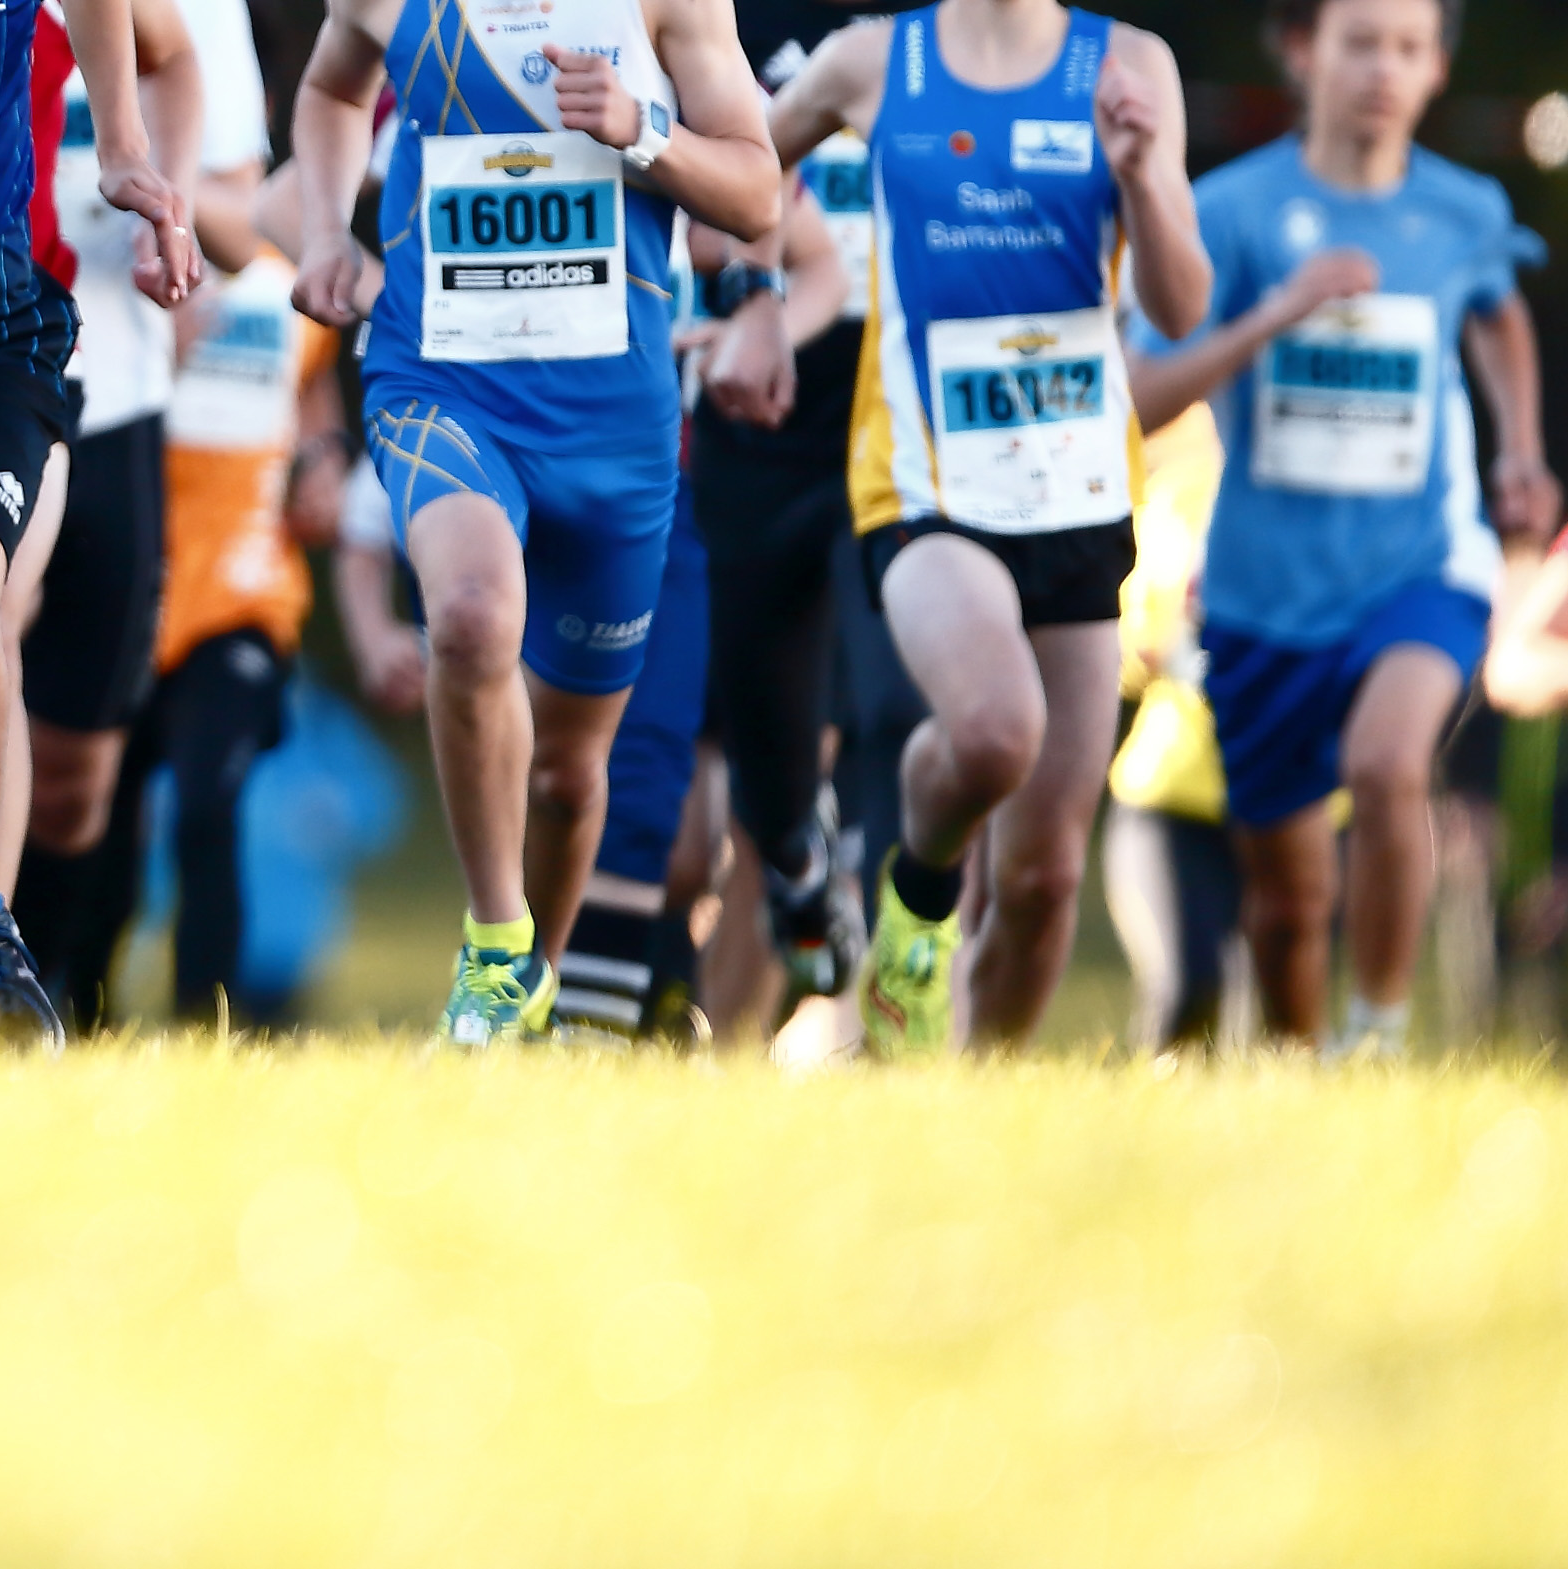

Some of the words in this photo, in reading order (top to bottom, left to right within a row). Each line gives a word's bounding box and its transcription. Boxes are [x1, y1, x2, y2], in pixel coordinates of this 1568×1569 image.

[439, 190, 598, 246] 16001
[506, 261, 595, 289] adidas
[954, 362, 1096, 422] 16042
